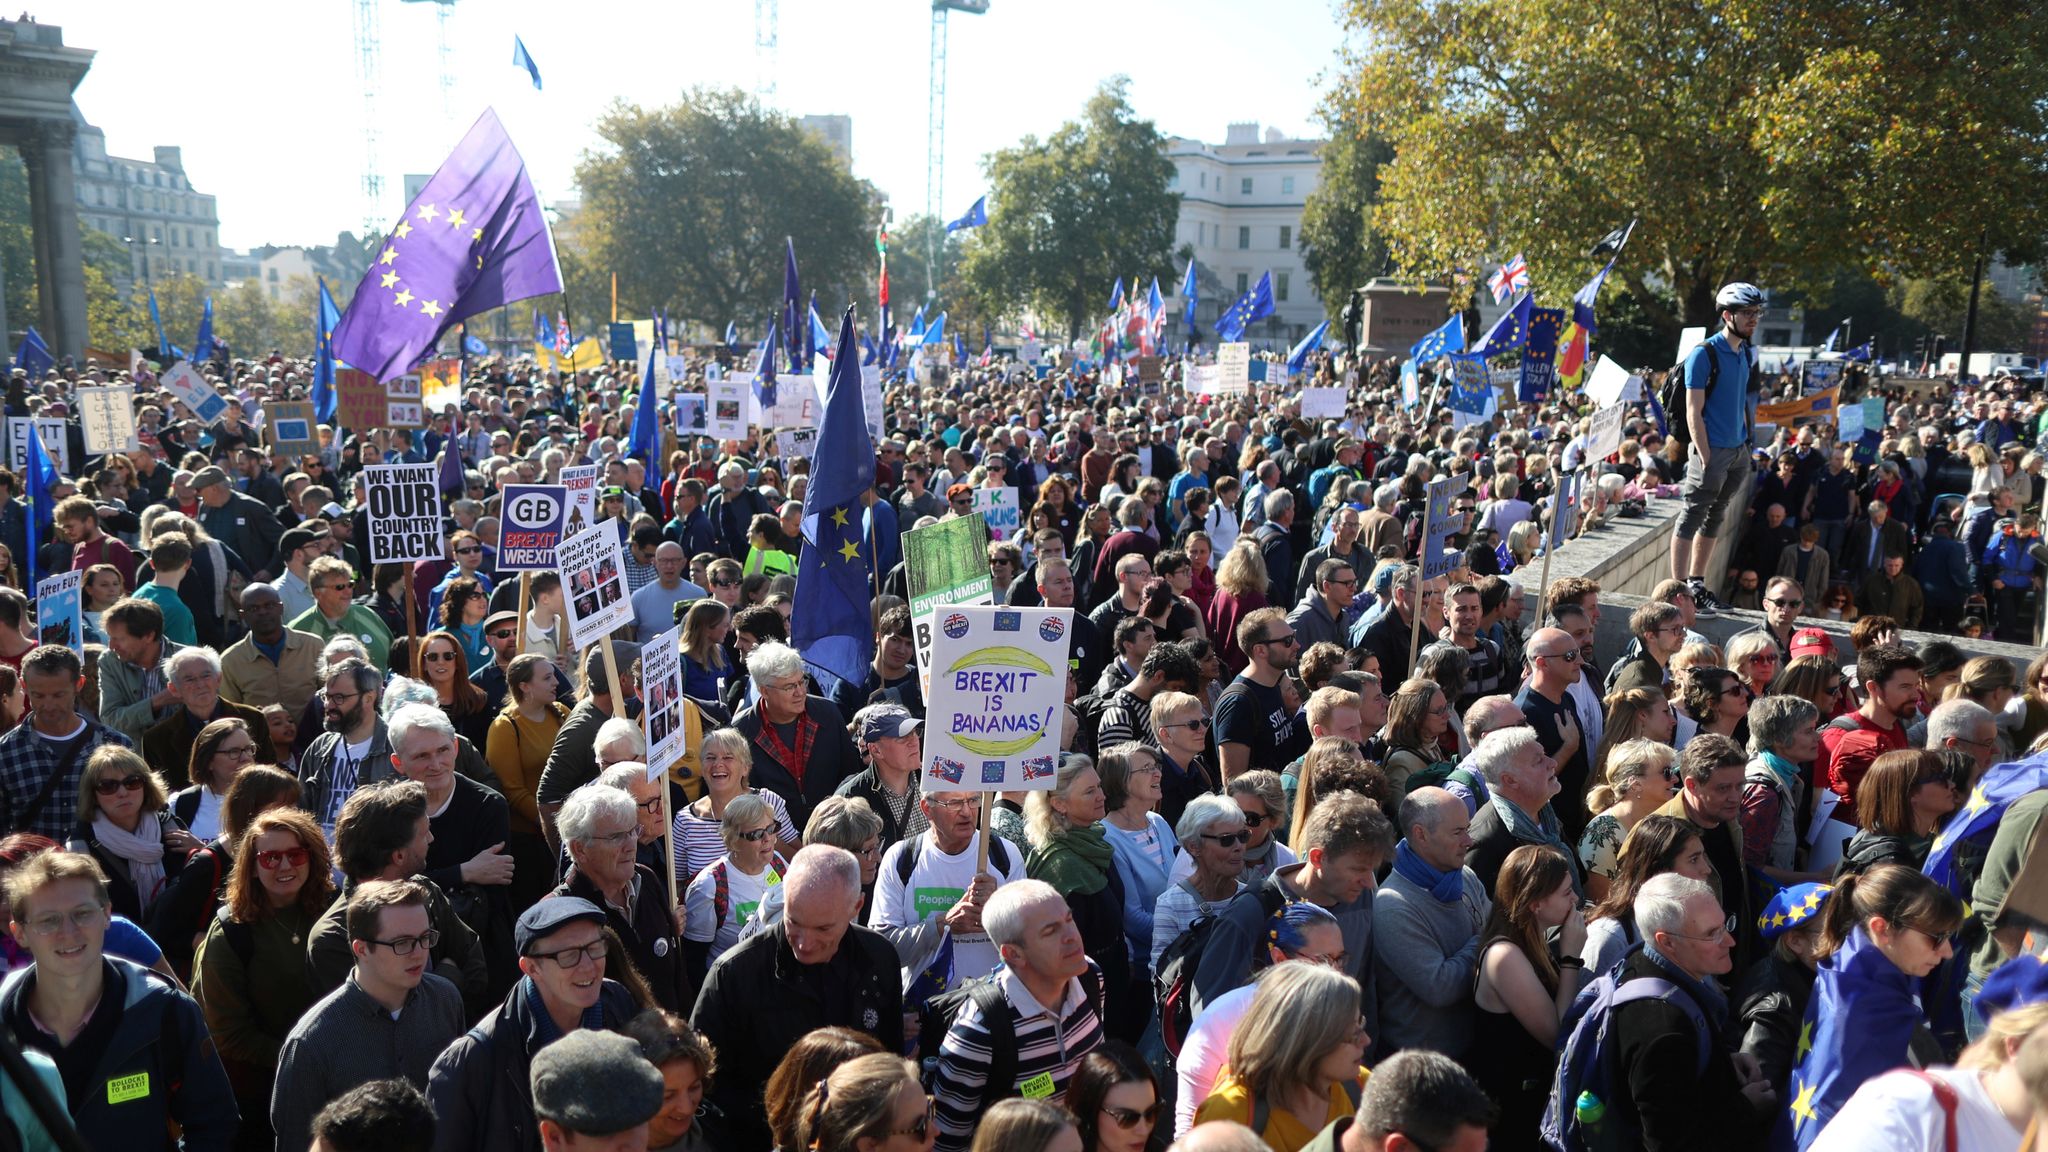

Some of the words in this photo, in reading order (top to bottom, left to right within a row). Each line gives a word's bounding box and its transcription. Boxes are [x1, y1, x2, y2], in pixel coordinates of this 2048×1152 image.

[187, 387, 206, 403] EU
[95, 403, 123, 413] CALL
[351, 410, 385, 428] YOU
[14, 423, 62, 439] EIT
[366, 470, 390, 485] WE
[392, 468, 435, 483] WANT
[369, 483, 437, 519] OUR
[971, 493, 985, 508] J.
[990, 490, 1006, 505] K.
[515, 498, 551, 522] GB
[984, 506, 1017, 527] WLING
[371, 517, 438, 535] COUNTRY
[373, 533, 441, 560] BACK
[504, 532, 558, 549] BREXIT
[559, 541, 582, 557] Who's
[583, 530, 602, 546] most
[504, 548, 556, 565] WREXIT
[561, 549, 585, 567] afraid
[586, 544, 594, 556] of
[595, 542, 601, 550] a
[563, 556, 595, 576] People's
[595, 542, 616, 560] Vote?
[1426, 558, 1449, 575] GIVE
[40, 582, 61, 599] After
[63, 575, 79, 590] EU?
[914, 578, 989, 614] ENVIRONMENT
[645, 645, 659, 662] Who's
[645, 659, 661, 676] afraid
[646, 668, 666, 687] People's
[955, 671, 1037, 693] BREXIT
[984, 694, 1003, 712] IS
[952, 706, 1054, 738] BANANAS!
[918, 894, 960, 906] People's
[111, 1075, 145, 1088] BOLLOCKS
[122, 1081, 145, 1091] BREXIT
